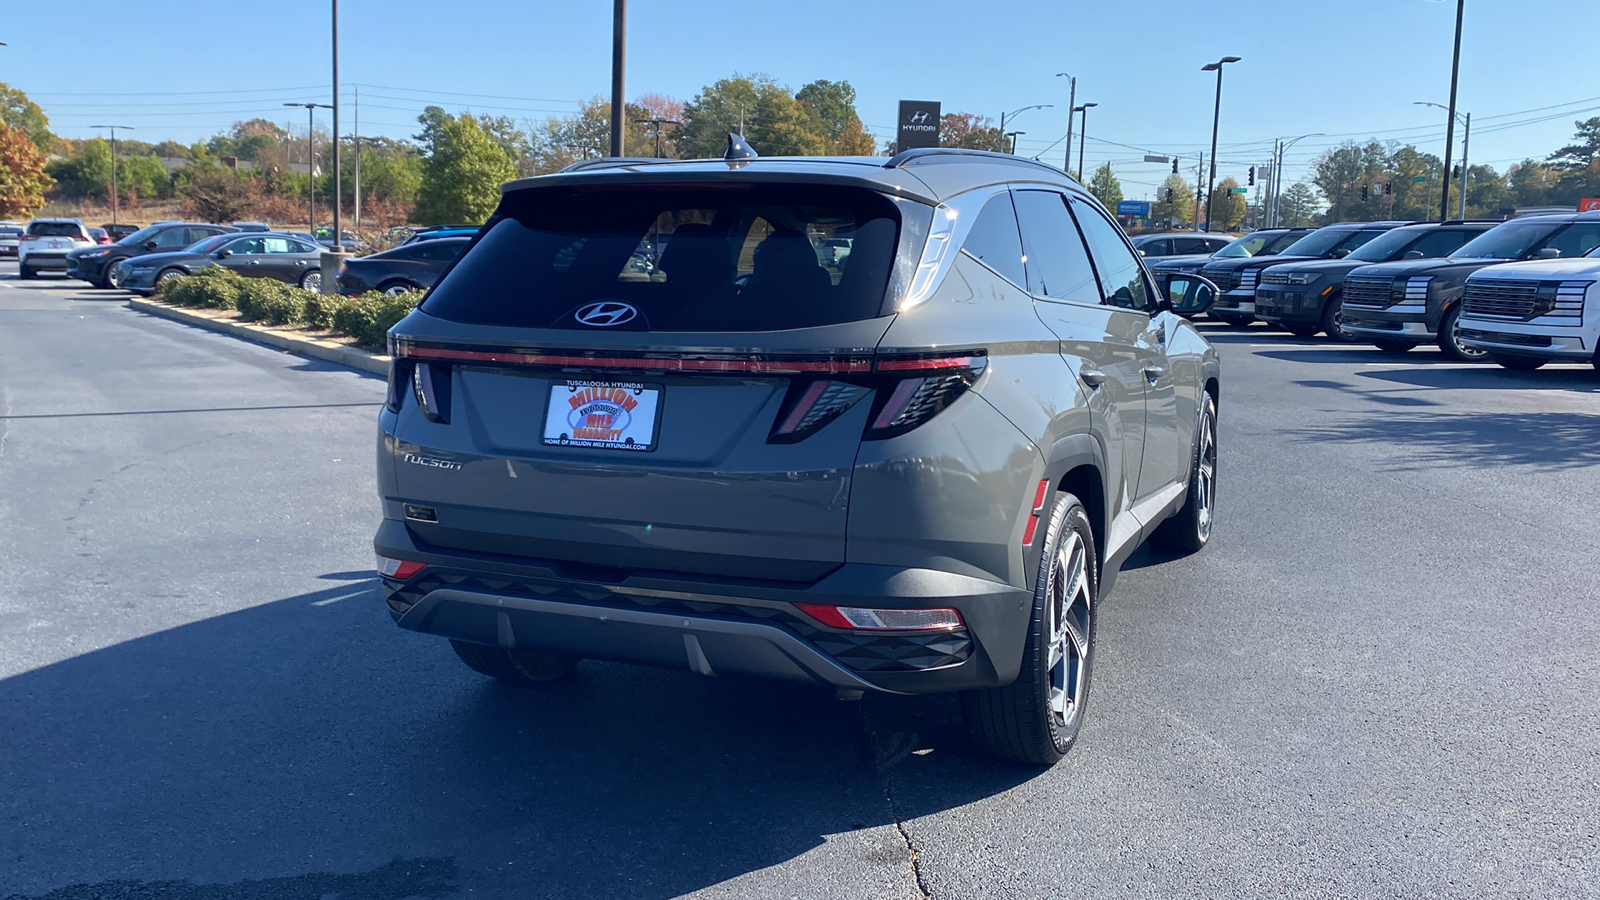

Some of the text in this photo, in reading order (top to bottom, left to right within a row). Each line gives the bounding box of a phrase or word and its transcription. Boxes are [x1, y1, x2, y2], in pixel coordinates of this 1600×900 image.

[902, 124, 936, 132] HYUNDAI
[568, 387, 639, 413] MILLION
[586, 414, 613, 429] MILE
[605, 442, 647, 450] HYUNDAI.COM
[401, 451, 463, 470] TUCSON
